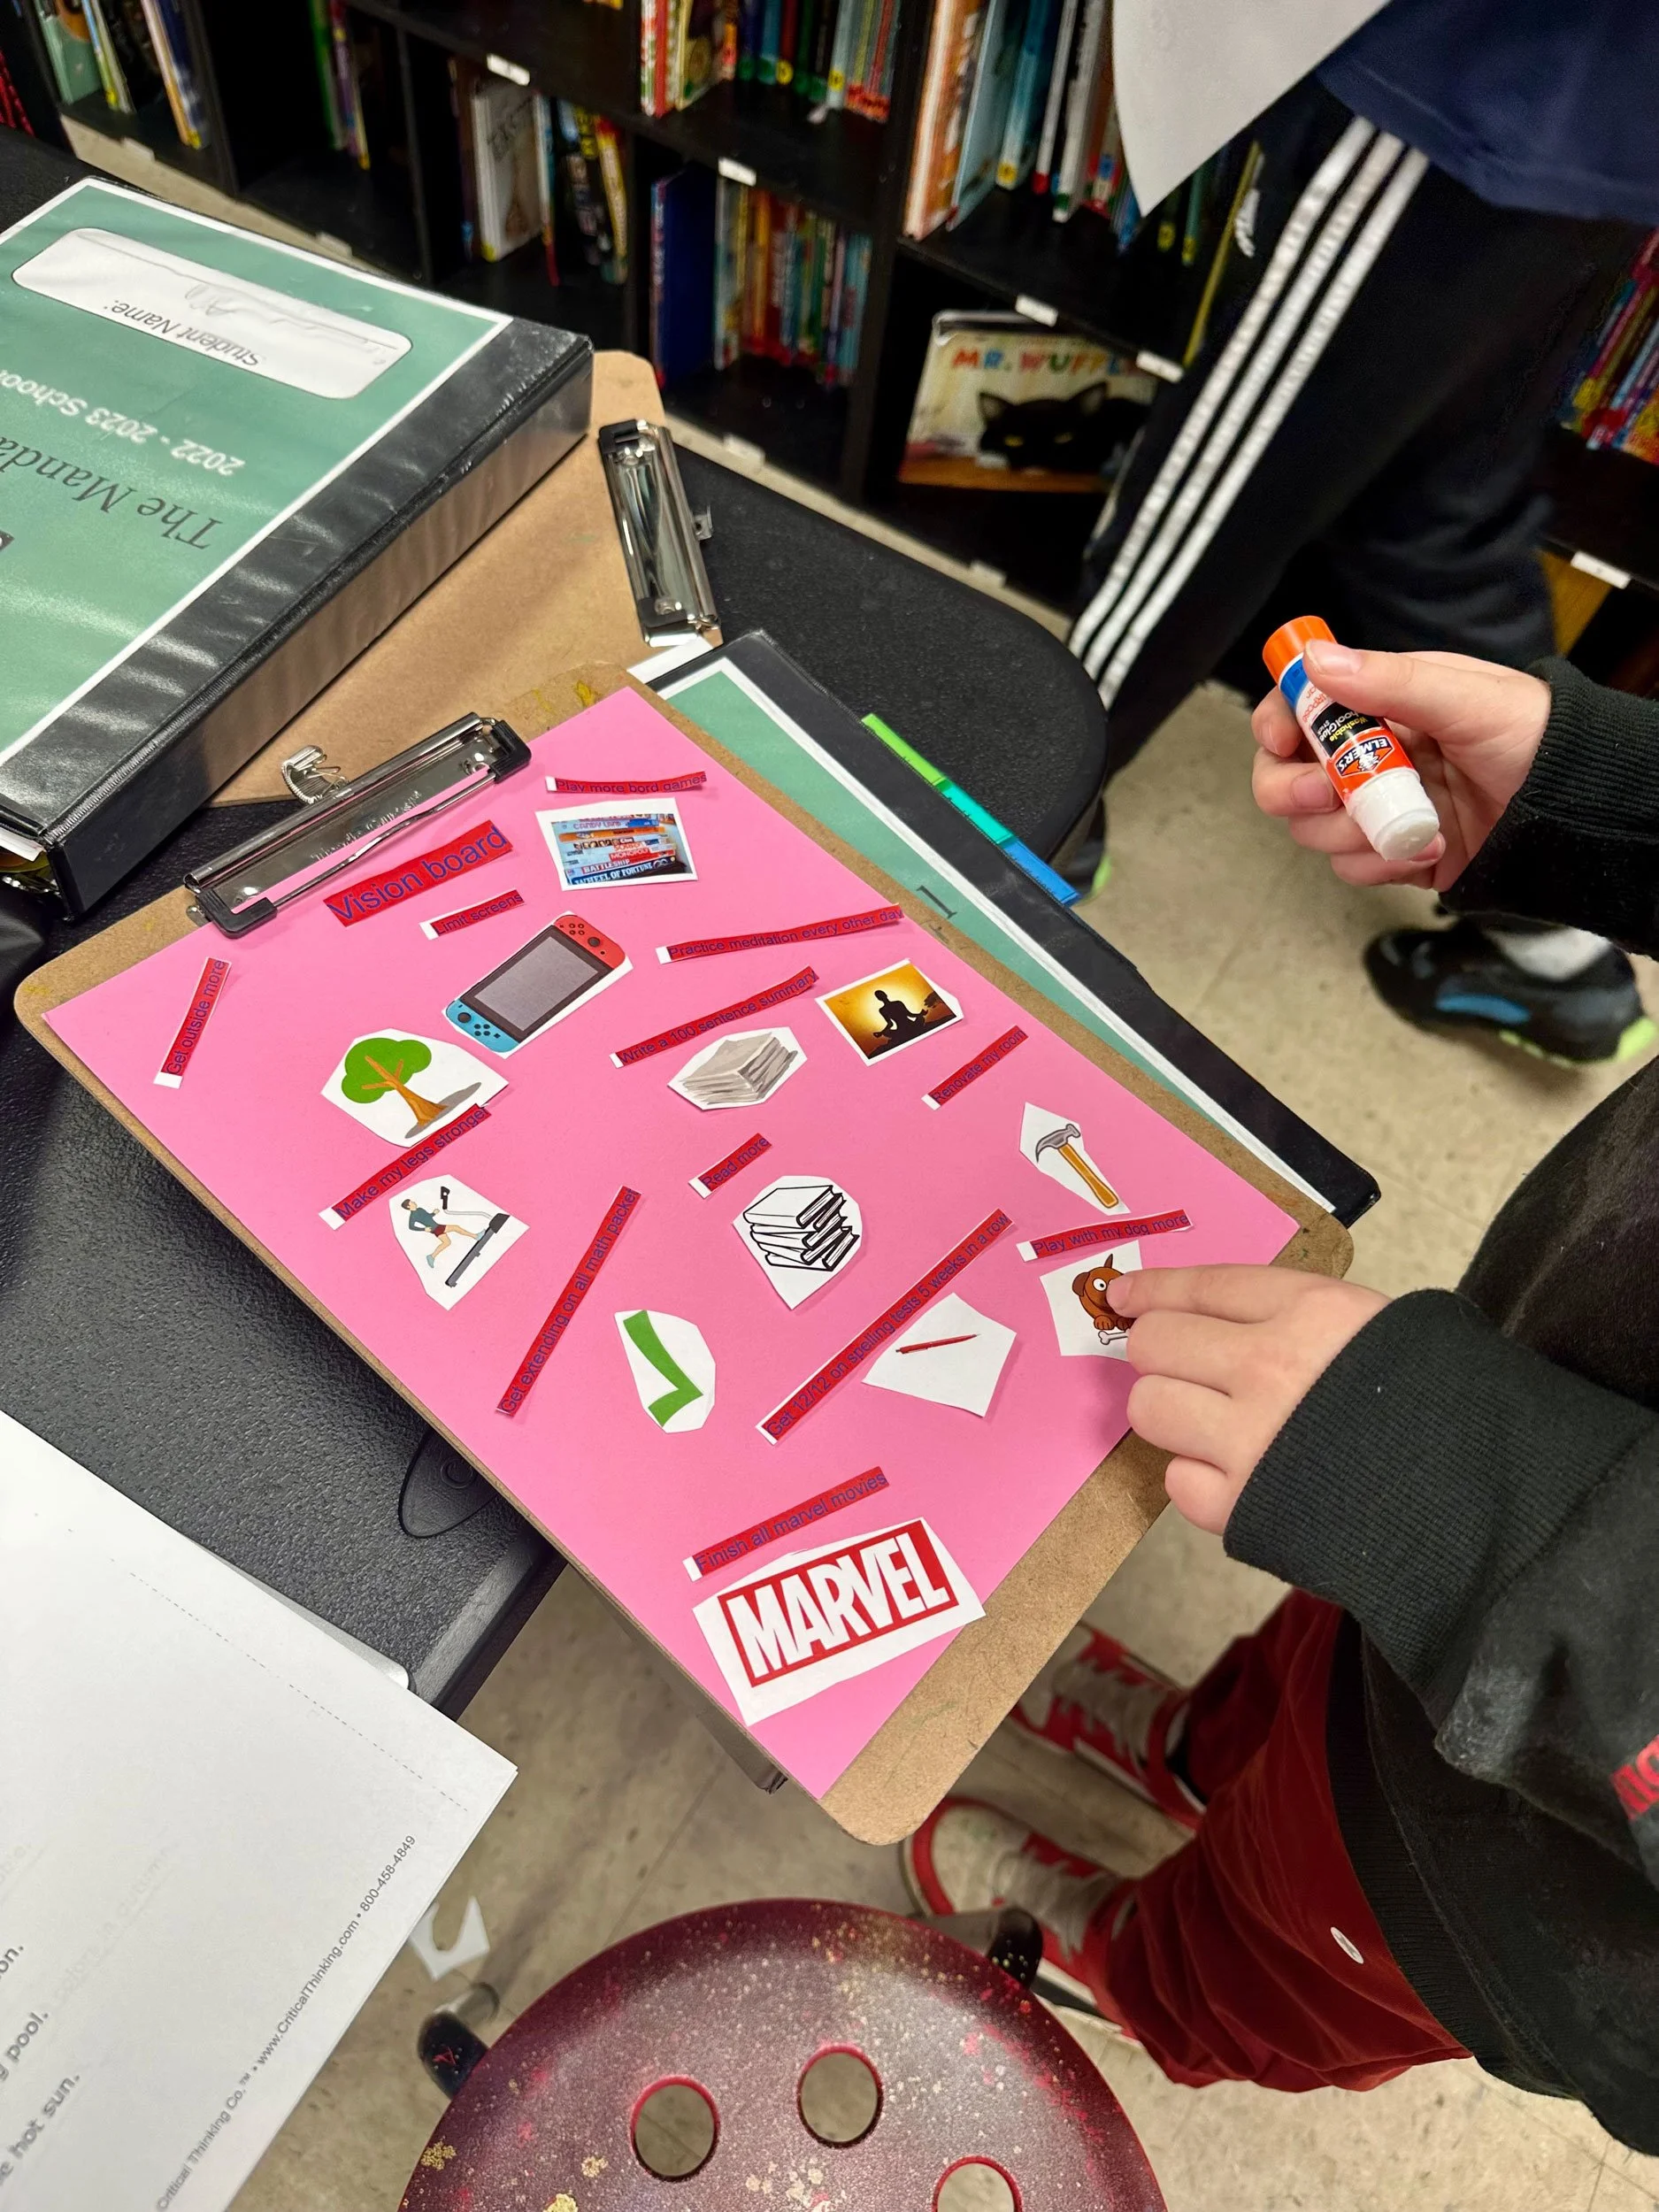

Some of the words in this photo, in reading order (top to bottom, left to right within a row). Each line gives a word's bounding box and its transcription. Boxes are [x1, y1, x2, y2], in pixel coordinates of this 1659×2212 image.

[105, 299, 174, 335] Name:
[177, 326, 260, 366] Student
[85, 407, 159, 445] 2023
[170, 439, 246, 476] 2022
[136, 496, 224, 550] The
[1329, 716, 1369, 742] Washable
[1338, 738, 1388, 772] ELMER'S
[555, 780, 586, 794] Play
[590, 784, 625, 795] more
[629, 780, 659, 795] bord
[664, 772, 708, 793] games
[326, 872, 424, 921] Vision
[421, 824, 510, 879] board
[583, 858, 631, 874] BATTLESHIP
[610, 848, 649, 859] MONOPOLY
[611, 869, 621, 880] OF
[432, 914, 469, 935] Limit
[470, 892, 525, 922] screens
[668, 940, 726, 958] Practice
[729, 931, 799, 949] meditation
[802, 922, 839, 940] every
[841, 914, 877, 931] other
[879, 905, 903, 923] day
[165, 1050, 188, 1076] Get
[181, 1000, 211, 1048] outside
[203, 959, 227, 997] more
[618, 1042, 657, 1064] Write
[659, 1037, 669, 1048] a
[670, 1025, 697, 1044] 100
[698, 1002, 758, 1033] sentence
[758, 970, 818, 1008] summary
[931, 1063, 984, 1103] Renovate
[982, 1049, 1002, 1068] my
[998, 1029, 1027, 1054] room
[334, 1184, 380, 1220] Make
[379, 1165, 403, 1188] my
[400, 1145, 435, 1165] legs
[700, 1159, 738, 1189] Read
[736, 1137, 770, 1165] more
[1032, 1239, 1067, 1256] Play
[1069, 1229, 1098, 1246] with
[1101, 1226, 1122, 1240] my
[1125, 1223, 1151, 1237] dog
[1152, 1214, 1190, 1232] more
[500, 1384, 527, 1415] Get
[520, 1313, 571, 1386] extending
[562, 1292, 580, 1312] on
[574, 1271, 592, 1292] all
[585, 1234, 612, 1273] math
[765, 1409, 795, 1438] Get
[792, 1375, 832, 1413] 12/12
[830, 1360, 849, 1379] on
[847, 1320, 896, 1363] spelling
[889, 1295, 922, 1325] tests
[917, 1285, 930, 1299] 5
[929, 1254, 967, 1289] weeks
[963, 1242, 979, 1256] in
[977, 1233, 989, 1245] a
[986, 1213, 1010, 1237] row
[694, 1537, 749, 1572] Finish
[750, 1525, 771, 1546] all
[772, 1500, 829, 1536] marvel
[830, 1471, 888, 1509] movies
[726, 1532, 950, 1679] MARVEL
[187, 2109, 232, 2164] Thinking
[257, 1918, 360, 2066] www.CriticalThinking.com
[359, 1834, 416, 1912] 800-458-4849
[6, 2010, 50, 2063] pool.
[8, 2117, 45, 2159] hot
[42, 2074, 81, 2118] sun.
